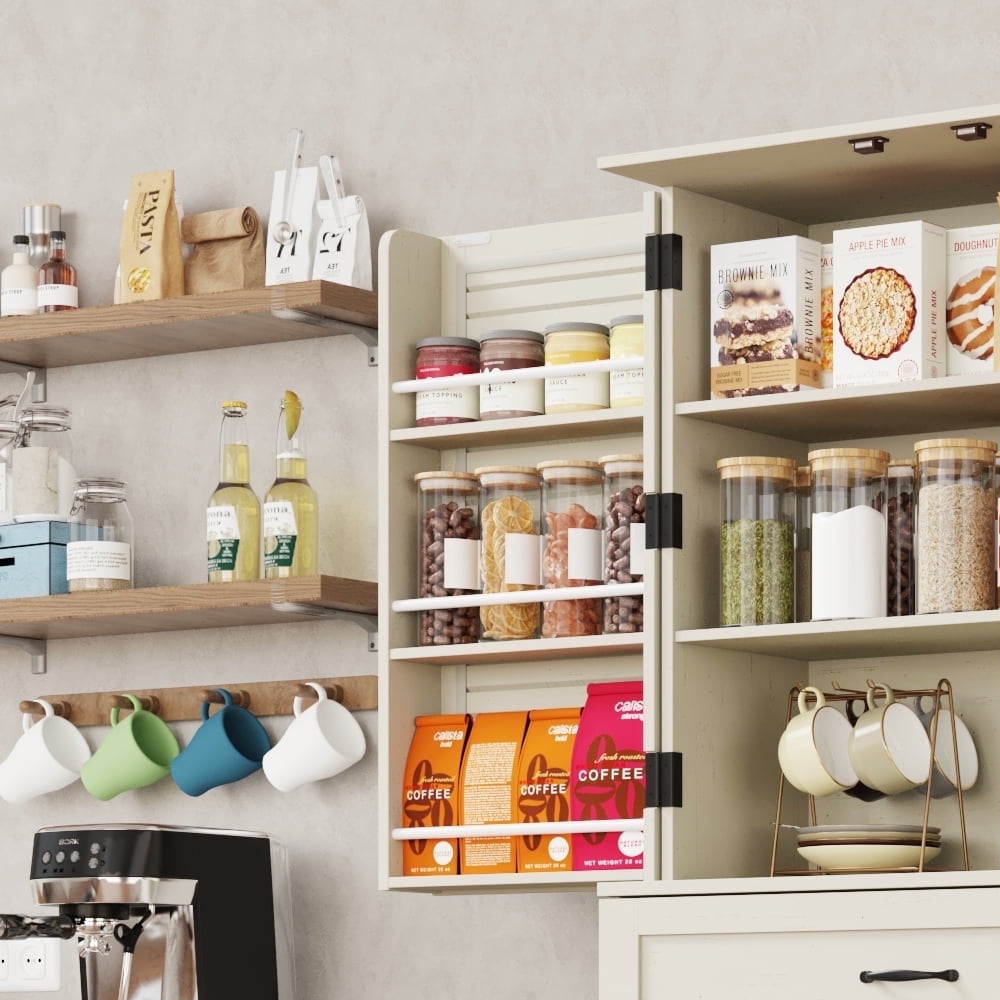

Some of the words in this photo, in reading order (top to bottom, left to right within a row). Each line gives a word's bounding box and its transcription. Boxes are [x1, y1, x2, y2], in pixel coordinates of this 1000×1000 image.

[139, 190, 160, 255] PASTA
[849, 241, 874, 252] APPLE
[876, 238, 889, 249] PIE
[891, 236, 906, 247] MIX
[718, 265, 765, 285] BROWNIE
[770, 262, 788, 279] MIX
[804, 268, 814, 291] MIX
[804, 298, 814, 354] BROWNIE
[432, 391, 463, 399] TOPPING
[594, 752, 618, 764] fresh
[578, 767, 644, 782] COFFEE
[407, 788, 451, 800] COFFEE
[520, 783, 567, 796] COFFEE
